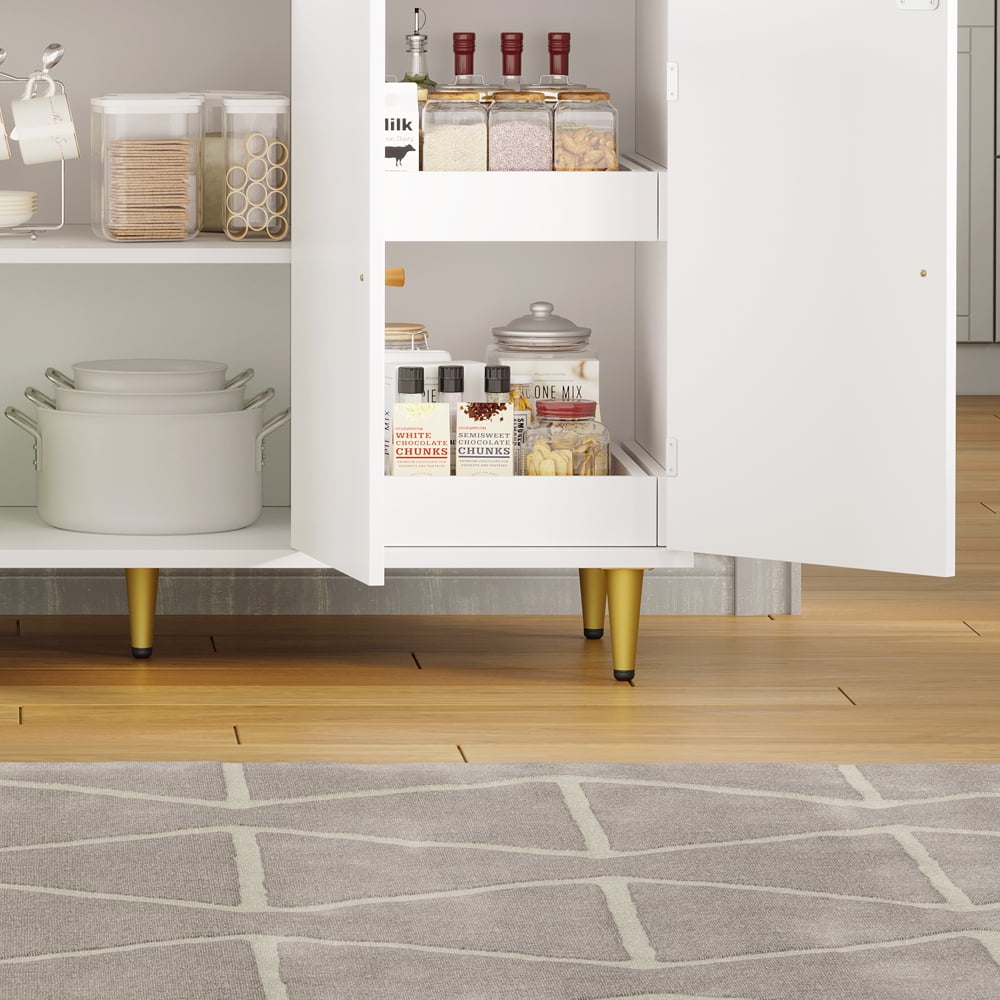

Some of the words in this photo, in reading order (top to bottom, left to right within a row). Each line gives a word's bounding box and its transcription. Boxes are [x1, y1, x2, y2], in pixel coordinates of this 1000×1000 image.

[385, 117, 413, 131] ilk
[562, 385, 583, 399] MIX
[395, 447, 448, 456] CHUNKS
[458, 447, 510, 455] CHUNKS
